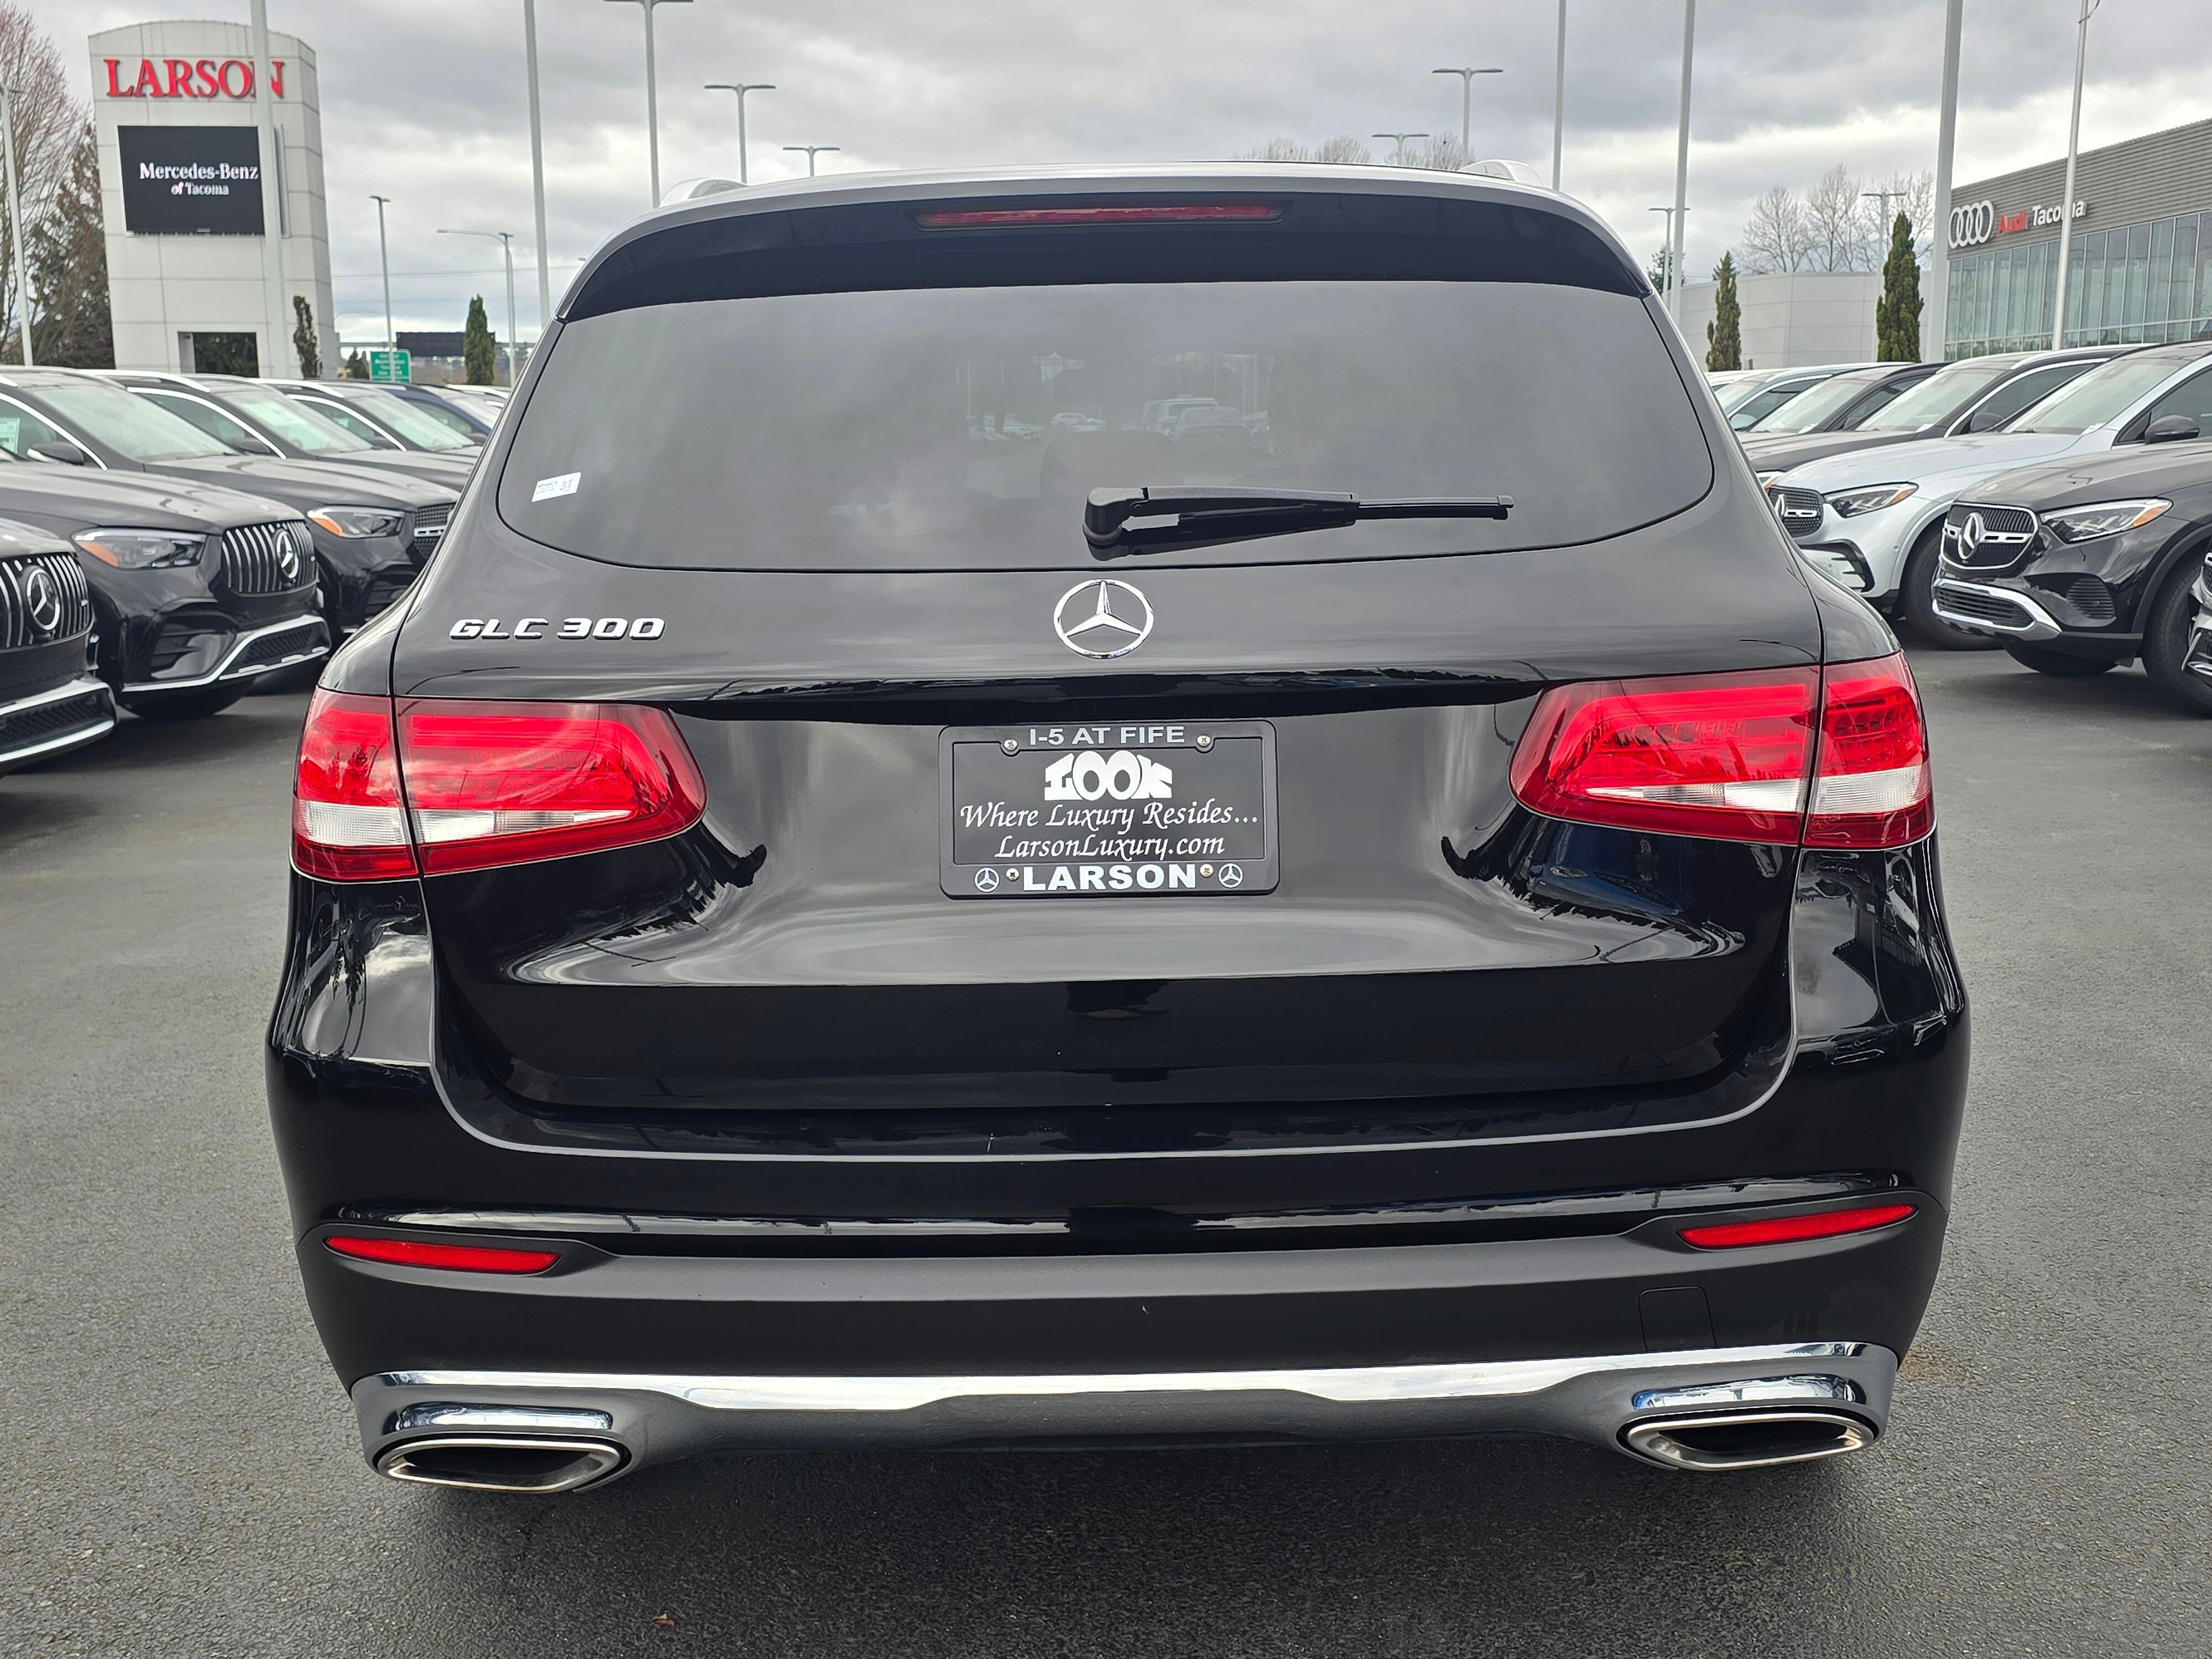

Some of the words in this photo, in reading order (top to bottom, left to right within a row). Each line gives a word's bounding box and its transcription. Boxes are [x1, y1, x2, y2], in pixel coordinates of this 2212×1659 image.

[103, 59, 285, 99] LARSON
[139, 162, 259, 180] Mercedes-Benz
[171, 181, 184, 195] of
[184, 181, 229, 195] Tacoma
[1997, 208, 2028, 236] Audi
[449, 618, 549, 640] GLC
[556, 617, 665, 640] 300
[1029, 728, 1064, 746] I-5
[1071, 727, 1111, 745] AT
[1120, 726, 1186, 744] FIFE
[960, 801, 1039, 828] Where
[1045, 804, 1135, 836] Luxury
[1142, 797, 1258, 830] Resides...
[994, 833, 1226, 862] LarsonLuxury.com
[1023, 863, 1196, 891] LARSON
